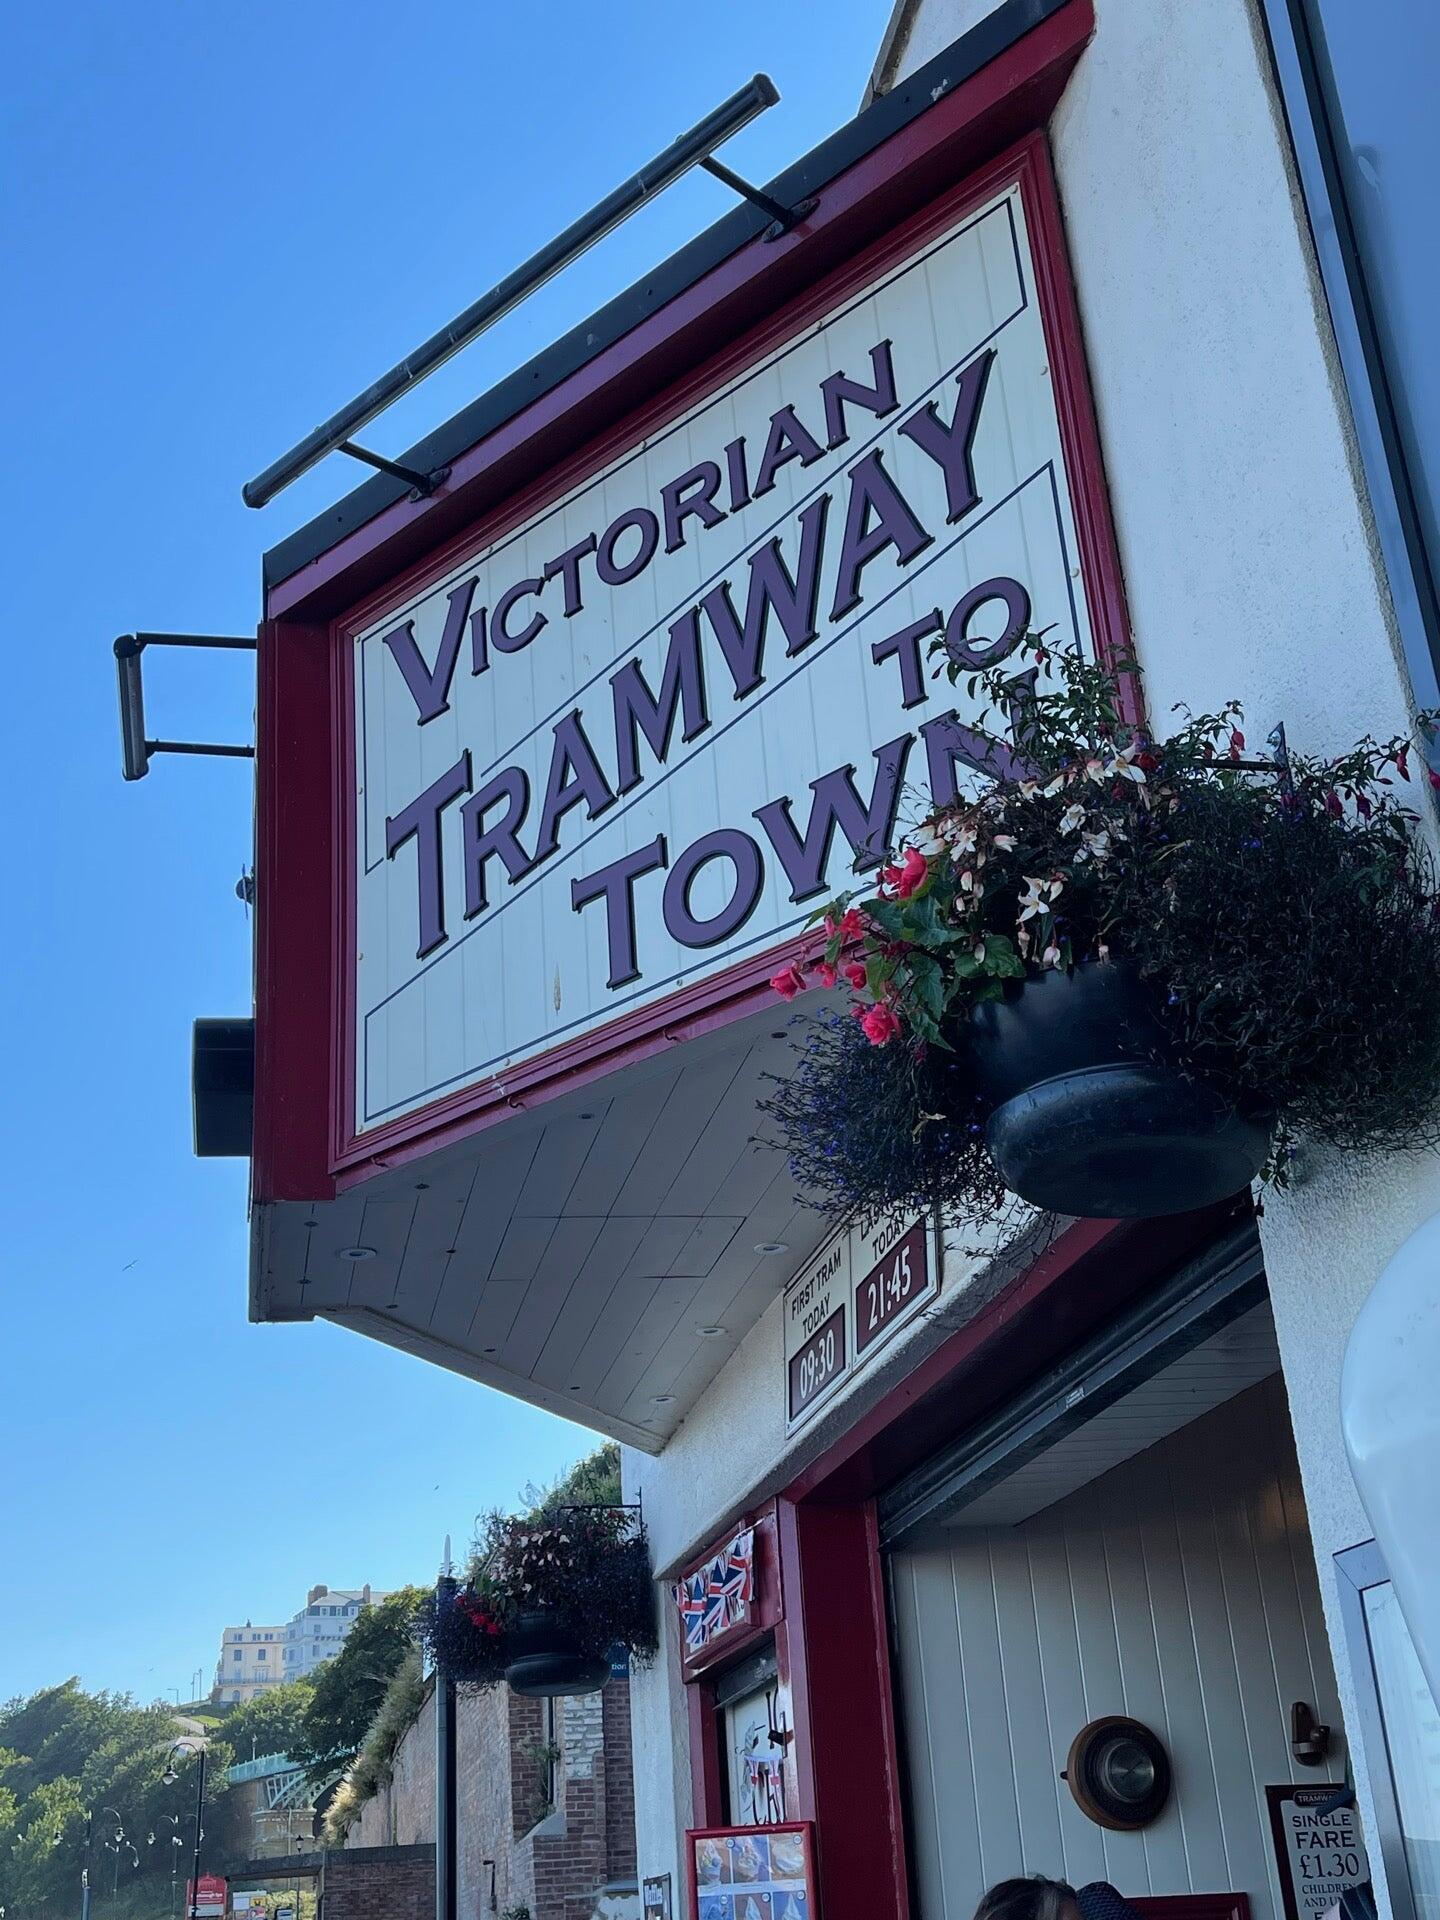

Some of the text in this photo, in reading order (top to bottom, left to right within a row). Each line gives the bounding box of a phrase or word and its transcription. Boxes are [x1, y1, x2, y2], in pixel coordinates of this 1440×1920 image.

[382, 338, 900, 726] VICTORIAN
[385, 347, 998, 960] TRAMWAY
[871, 577, 1033, 710] TO
[872, 1207, 906, 1261] TODAY
[792, 1246, 842, 1321] FIRST TRAM
[867, 1245, 912, 1331] 21:45
[802, 1292, 830, 1339] TODAY
[800, 1328, 835, 1399] 09:30
[1292, 1814, 1352, 1828] SINGLE
[1297, 1794, 1333, 1803] TRAMW
[1296, 1830, 1356, 1849] FARE
[1299, 1852, 1360, 1879] £1.30
[1304, 1897, 1327, 1908] AND
